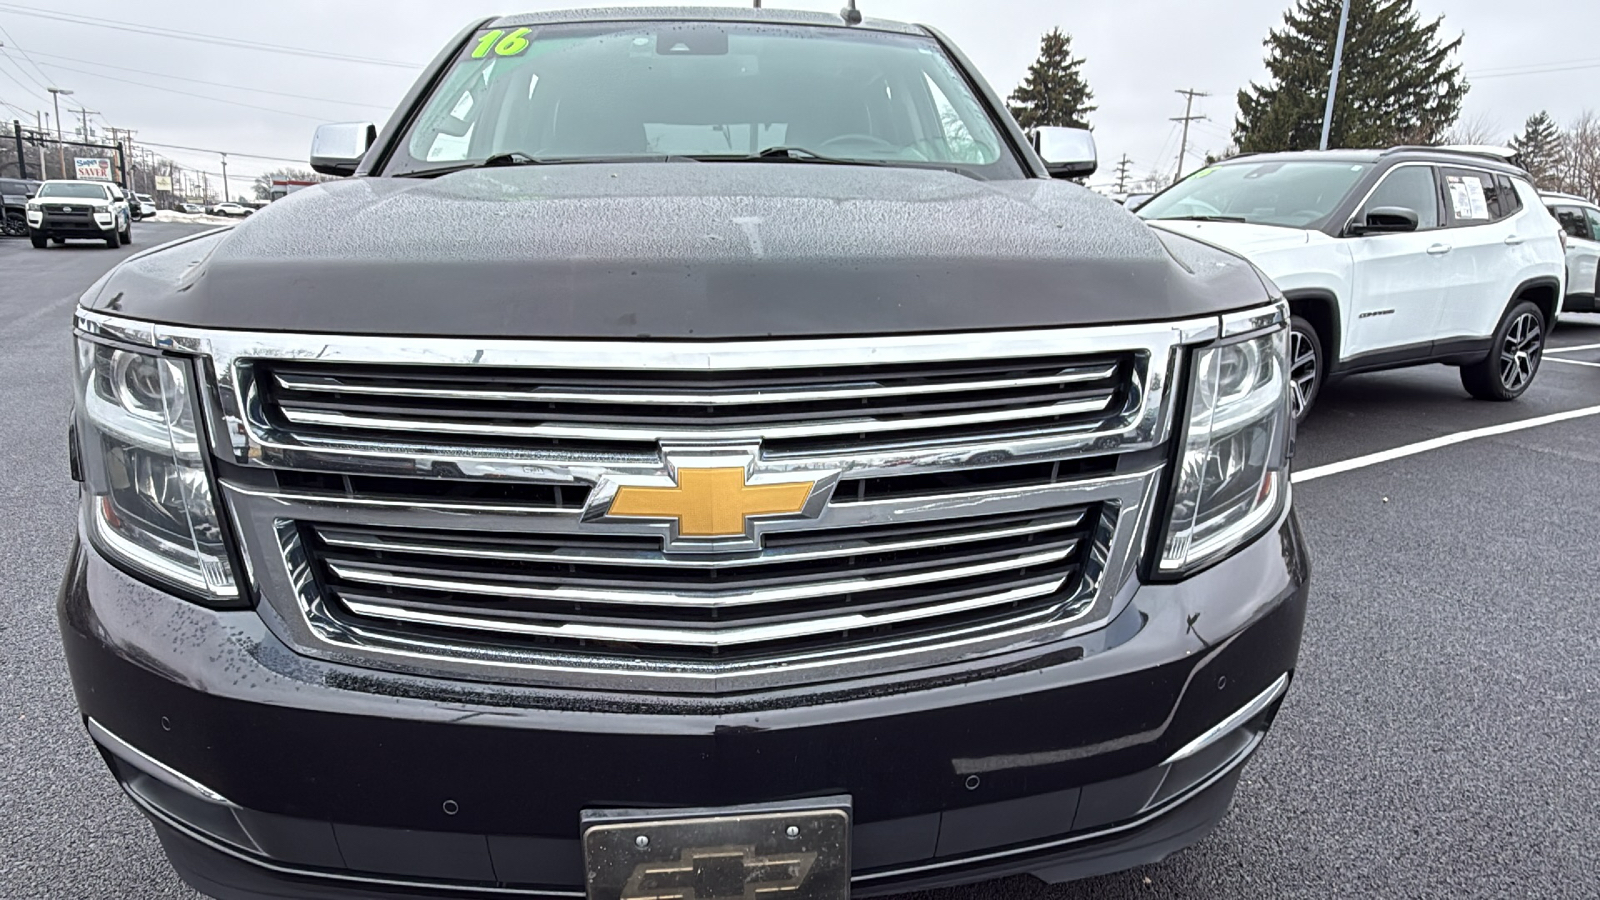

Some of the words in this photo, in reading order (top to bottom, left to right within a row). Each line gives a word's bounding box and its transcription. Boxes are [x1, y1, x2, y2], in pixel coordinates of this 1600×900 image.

[471, 27, 533, 58] 16
[76, 159, 98, 167] Super
[78, 167, 108, 177] SAVER
